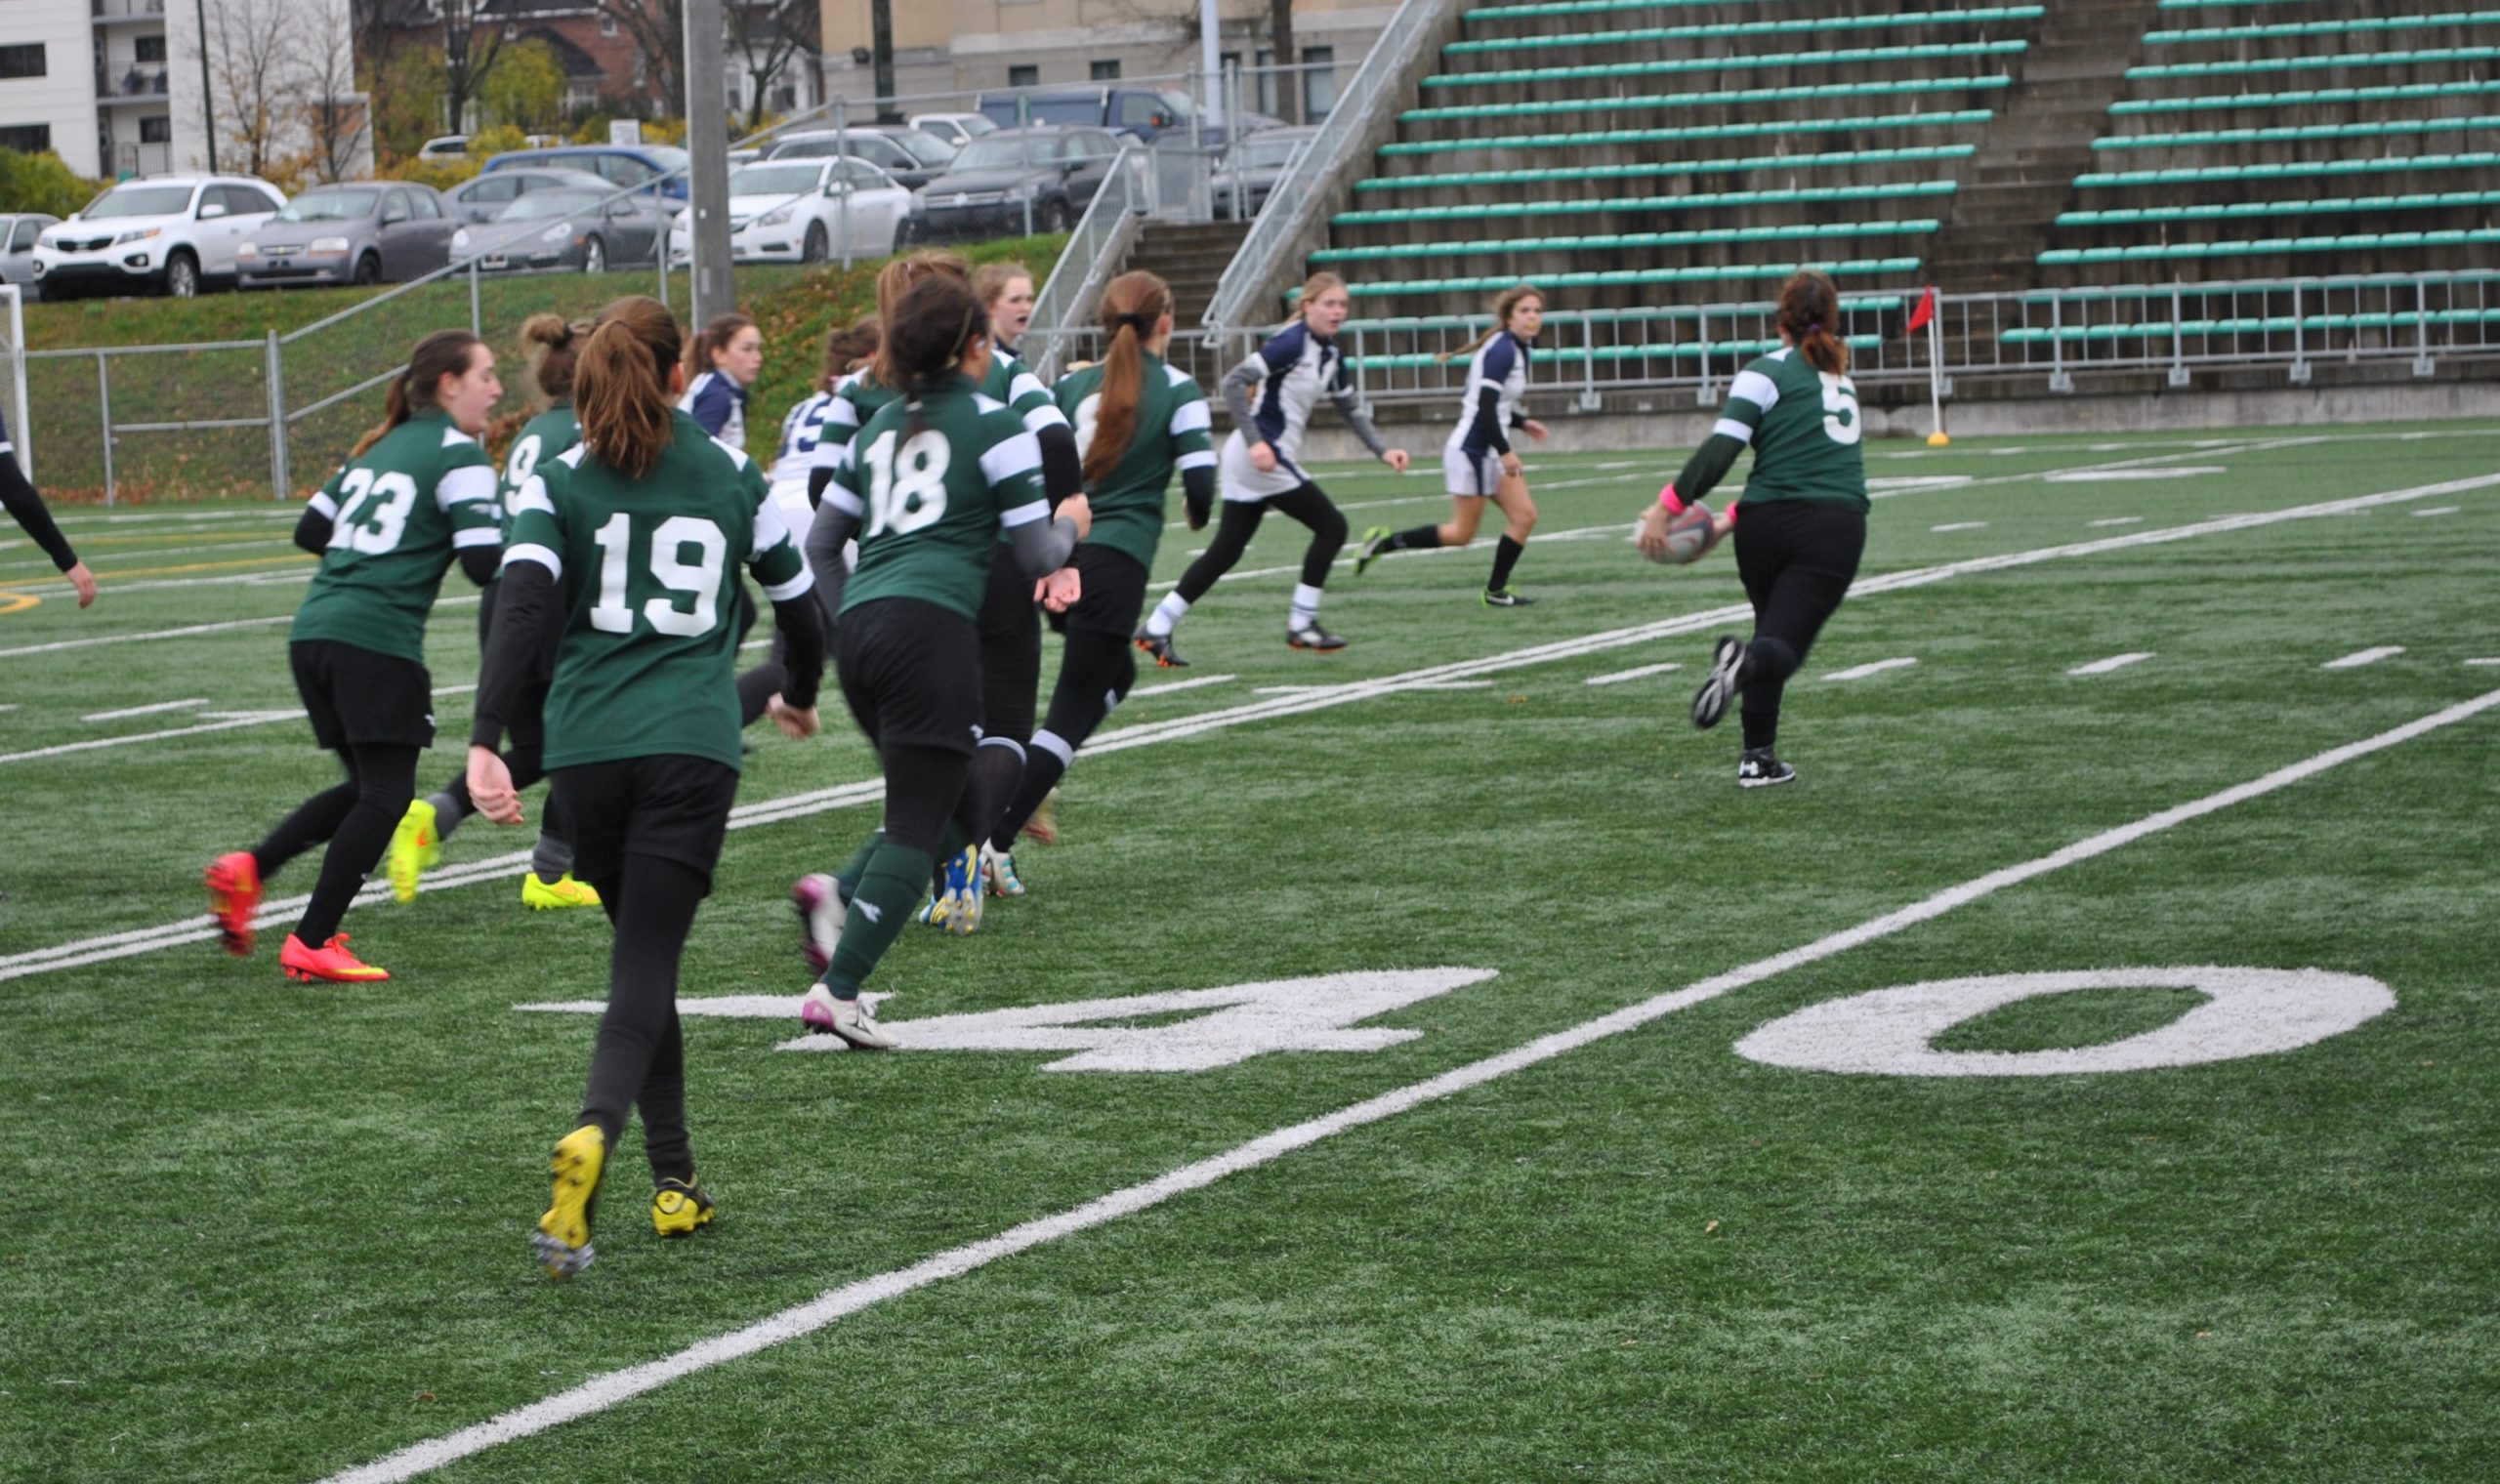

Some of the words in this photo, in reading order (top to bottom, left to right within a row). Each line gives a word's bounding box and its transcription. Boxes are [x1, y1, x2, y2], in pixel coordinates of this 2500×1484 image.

[1818, 371, 1861, 445] 5
[326, 468, 418, 555] 23
[862, 430, 951, 538] 18
[590, 513, 728, 638] 19
